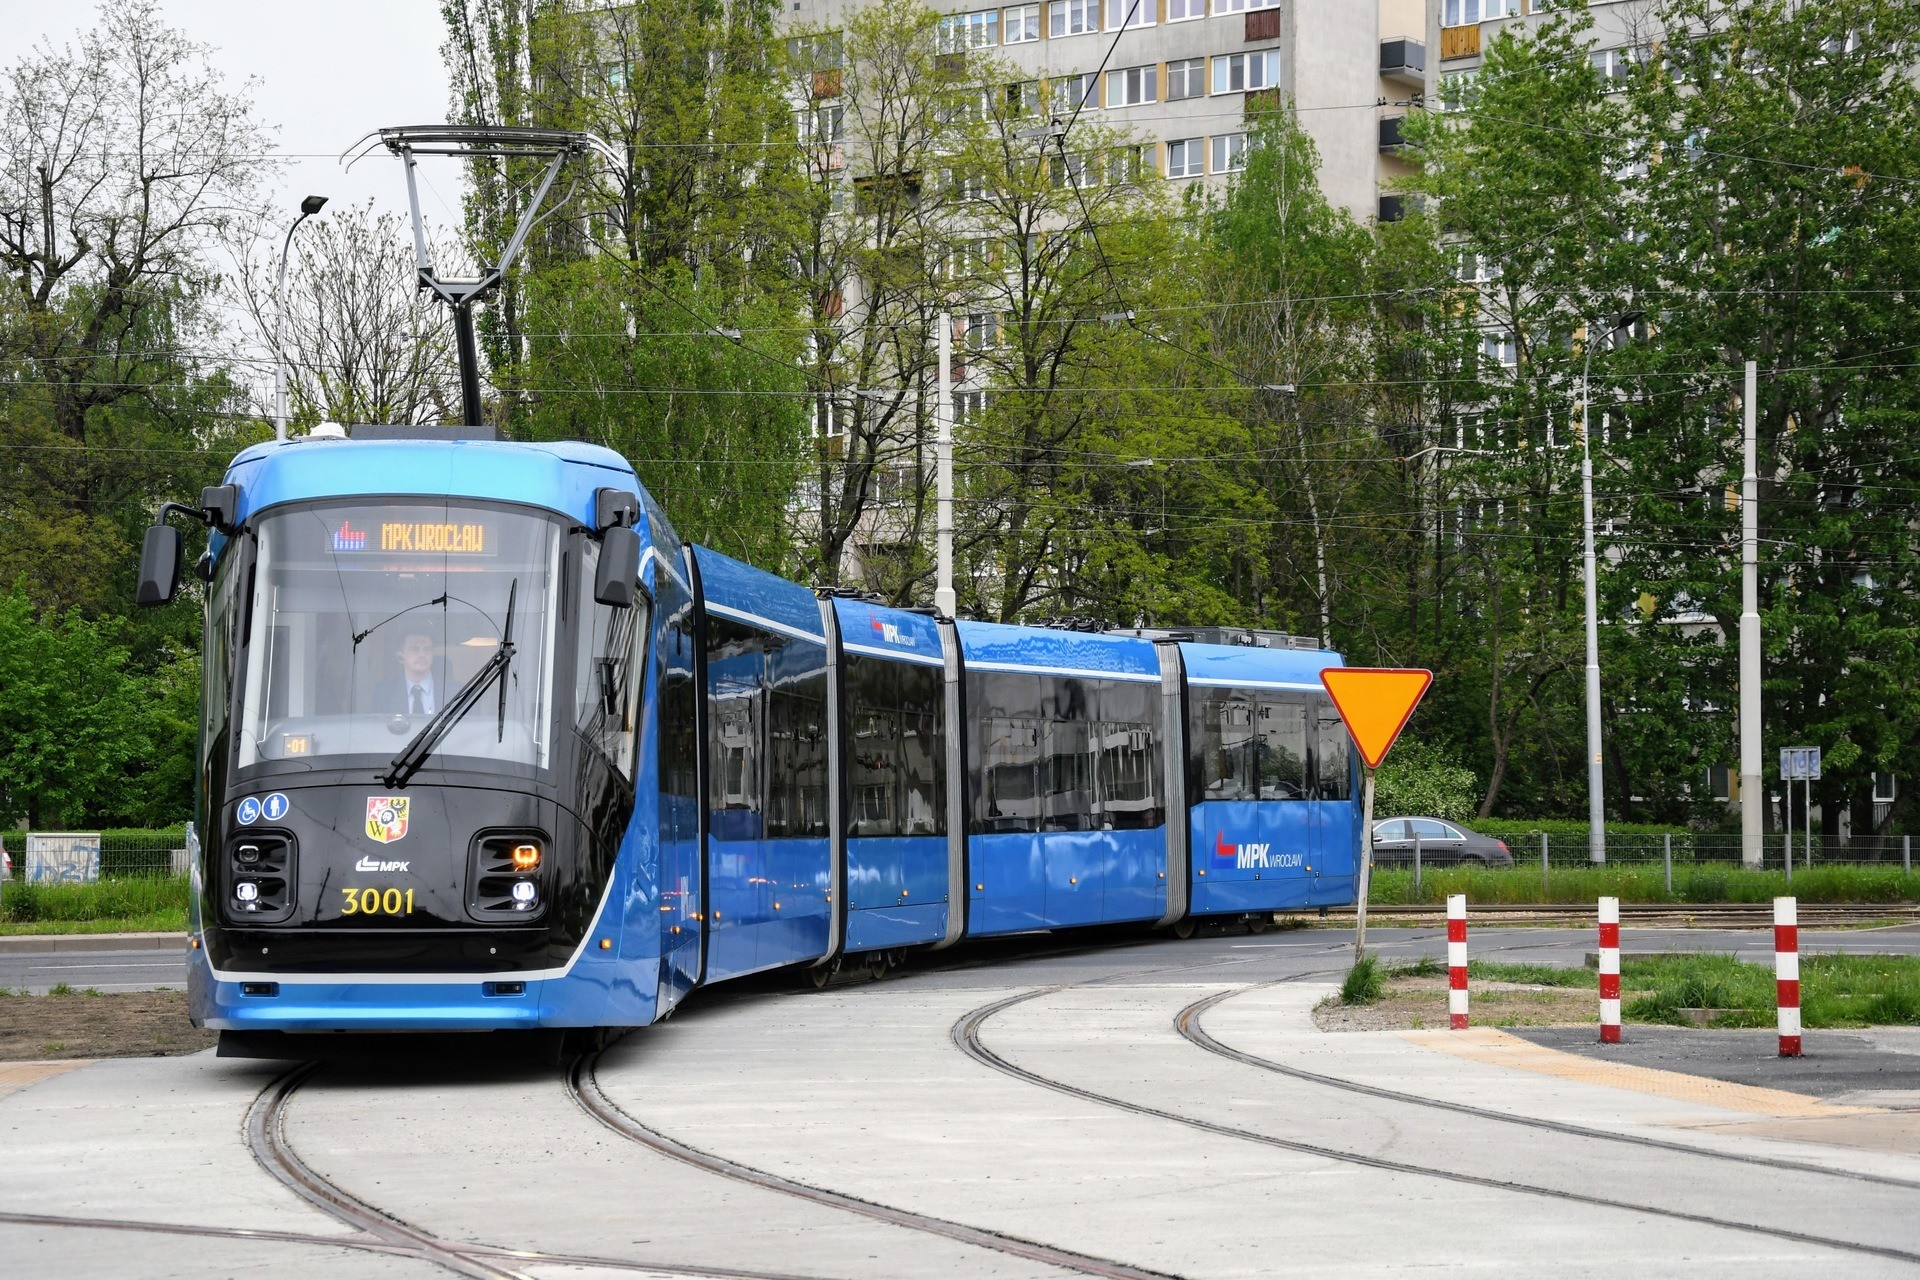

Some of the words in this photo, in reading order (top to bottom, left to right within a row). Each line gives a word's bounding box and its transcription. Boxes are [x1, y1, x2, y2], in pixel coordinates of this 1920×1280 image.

[381, 523, 413, 550] MPK
[414, 524, 483, 552] WROCŁAW
[882, 622, 900, 644] MPK
[379, 861, 411, 872] MPK
[1237, 843, 1270, 869] MPK
[1269, 853, 1303, 868] WROCŁAW
[341, 888, 414, 915] 3001
